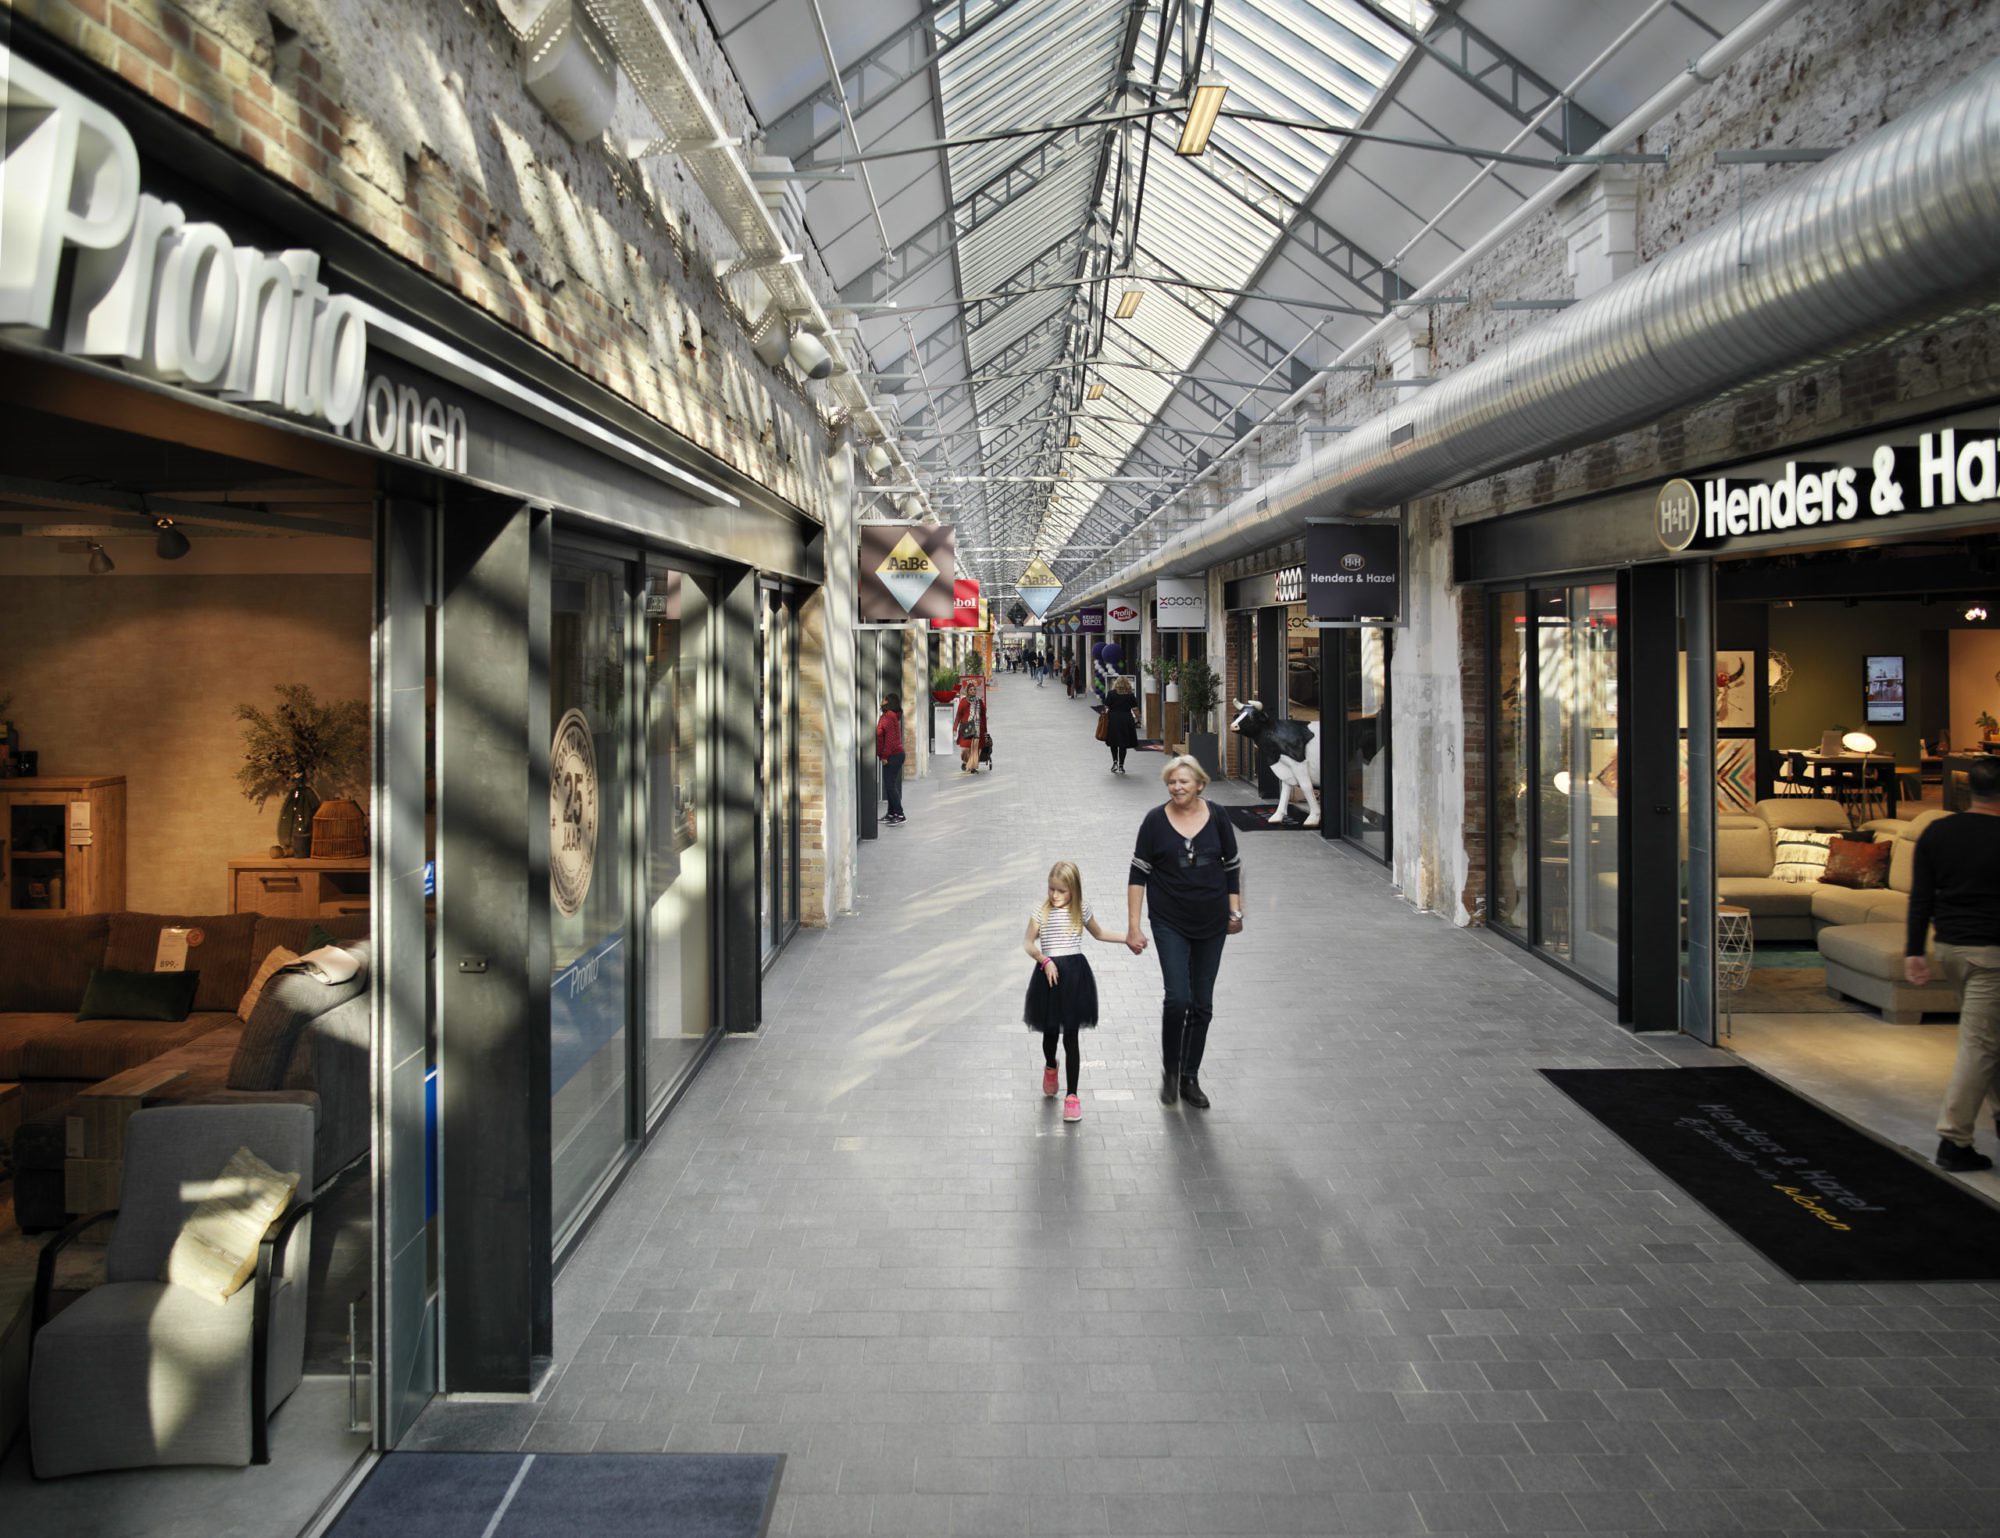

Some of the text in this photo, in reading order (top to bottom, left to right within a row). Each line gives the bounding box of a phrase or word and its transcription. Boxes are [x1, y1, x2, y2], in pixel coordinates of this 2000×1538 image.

[0, 48, 367, 427] Pronto
[1704, 428, 2000, 538] Henders & Ha
[887, 556, 929, 571] AaBe
[1022, 574, 1056, 586] AaBe
[1311, 573, 1396, 583] Henders & Hazel
[953, 597, 977, 607] bol
[563, 771, 584, 825] 25
[561, 826, 582, 852] JAAR
[570, 955, 599, 999] Pronto
[1697, 1104, 1788, 1153] Henders
[1795, 1169, 1887, 1211] Hazel
